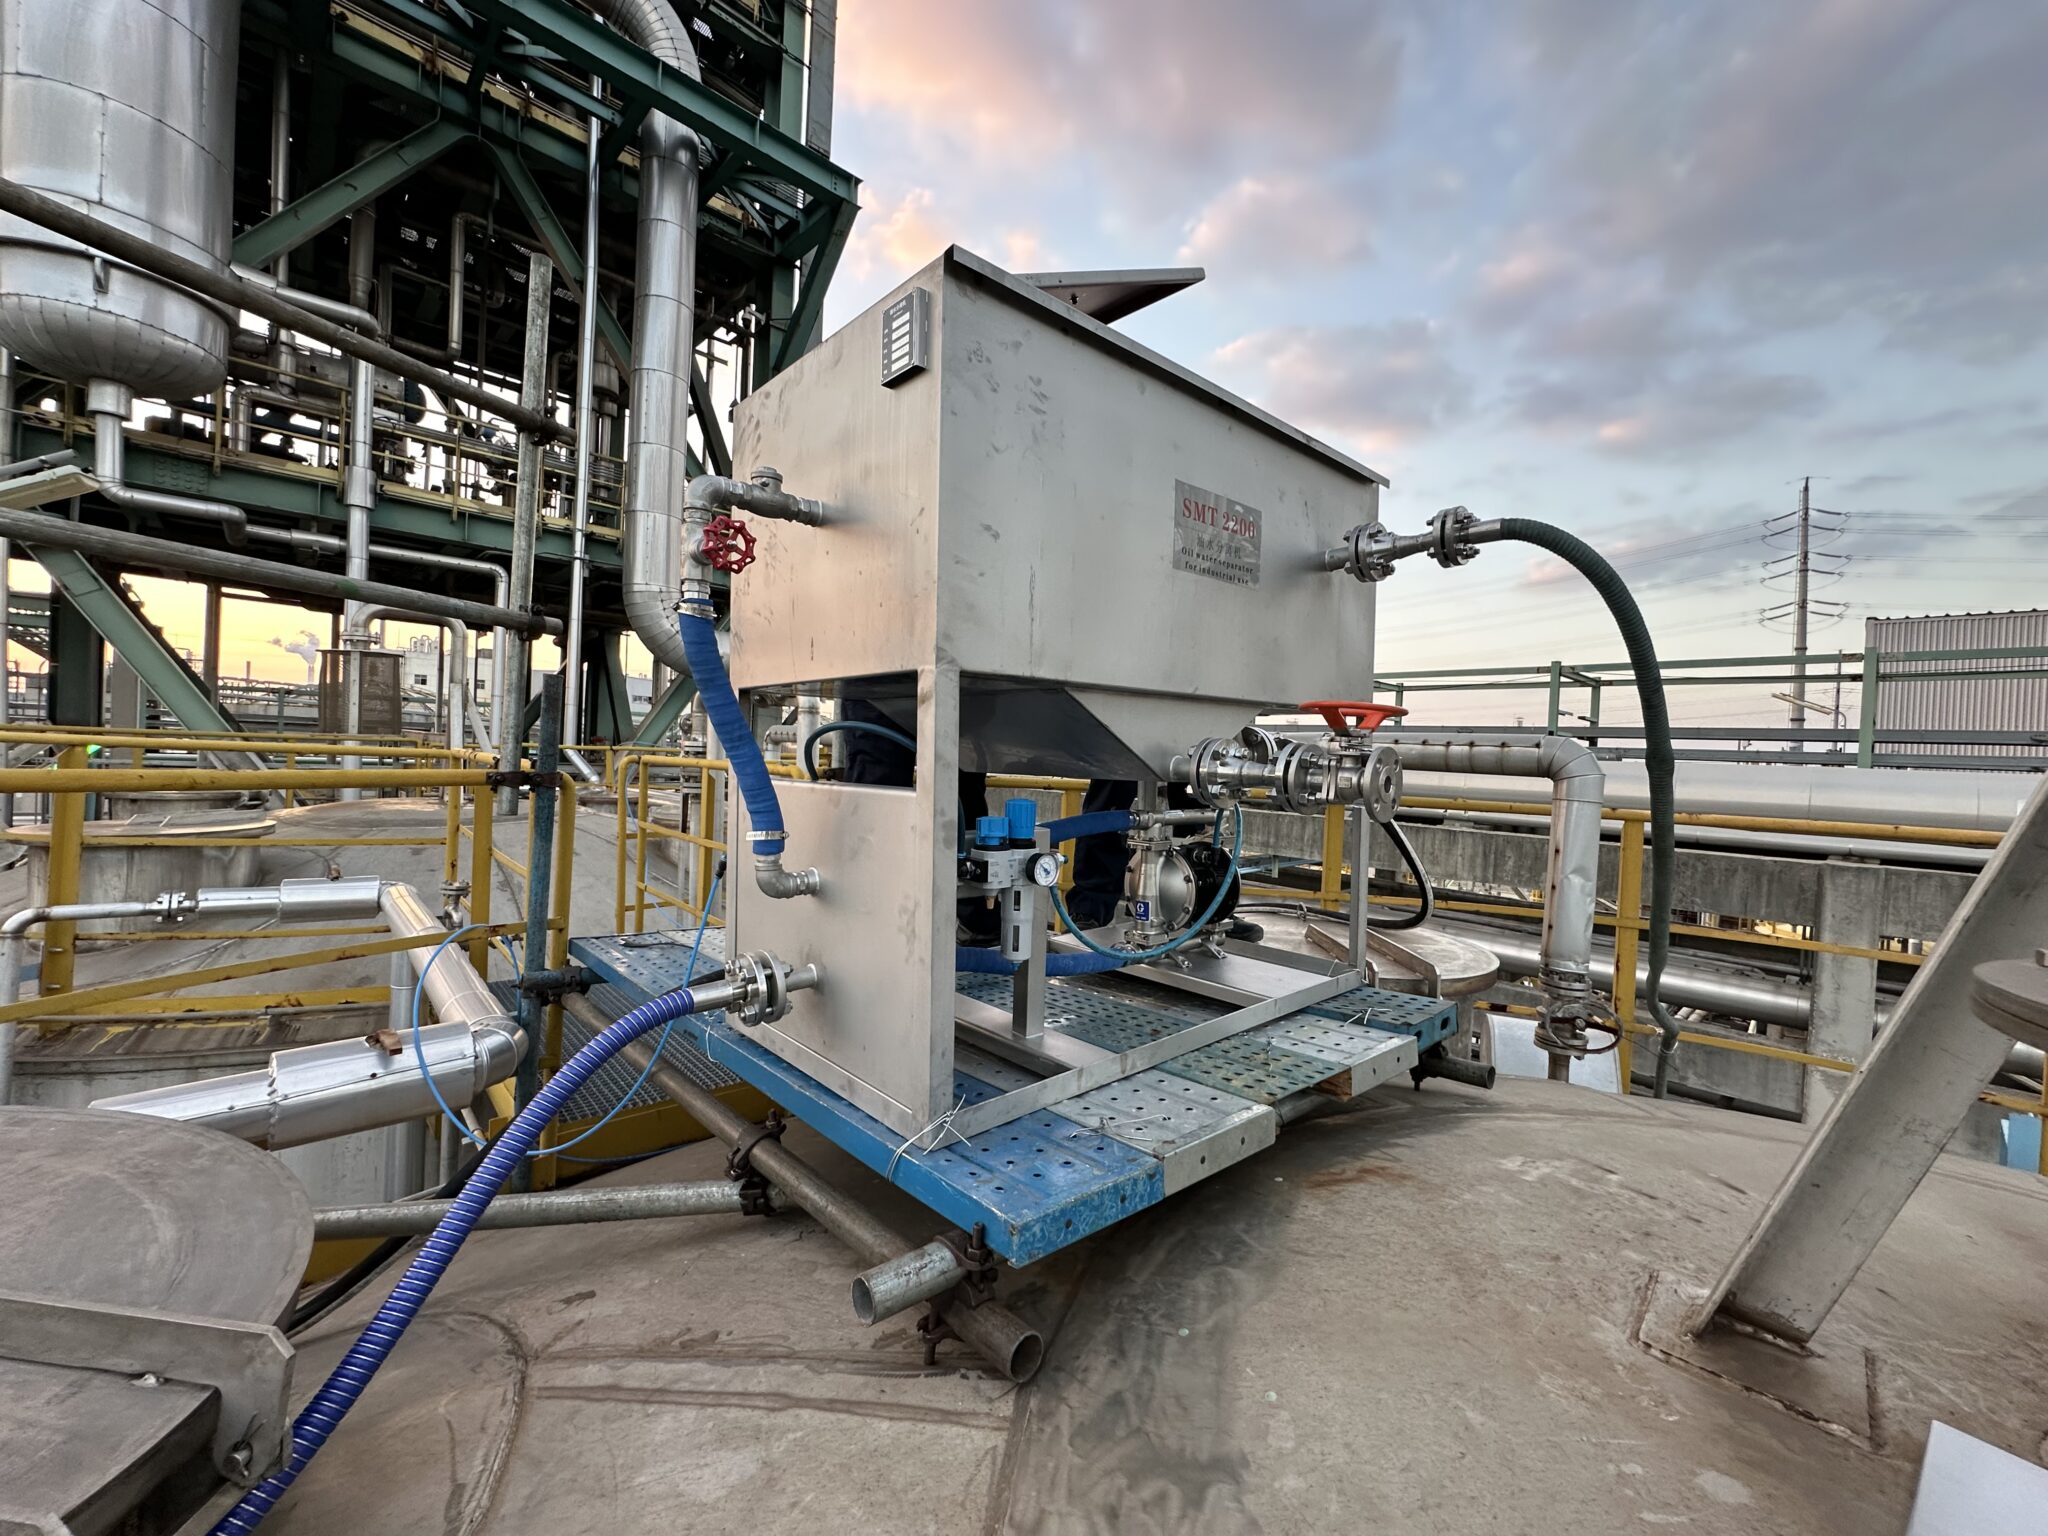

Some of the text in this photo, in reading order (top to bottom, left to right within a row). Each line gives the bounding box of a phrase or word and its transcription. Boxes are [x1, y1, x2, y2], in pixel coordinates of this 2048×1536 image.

[1183, 498, 1256, 539] SMT 2200
[1182, 546, 1253, 574] Oil water separator
[1185, 560, 1197, 571] for
[1199, 566, 1236, 582] industrial
